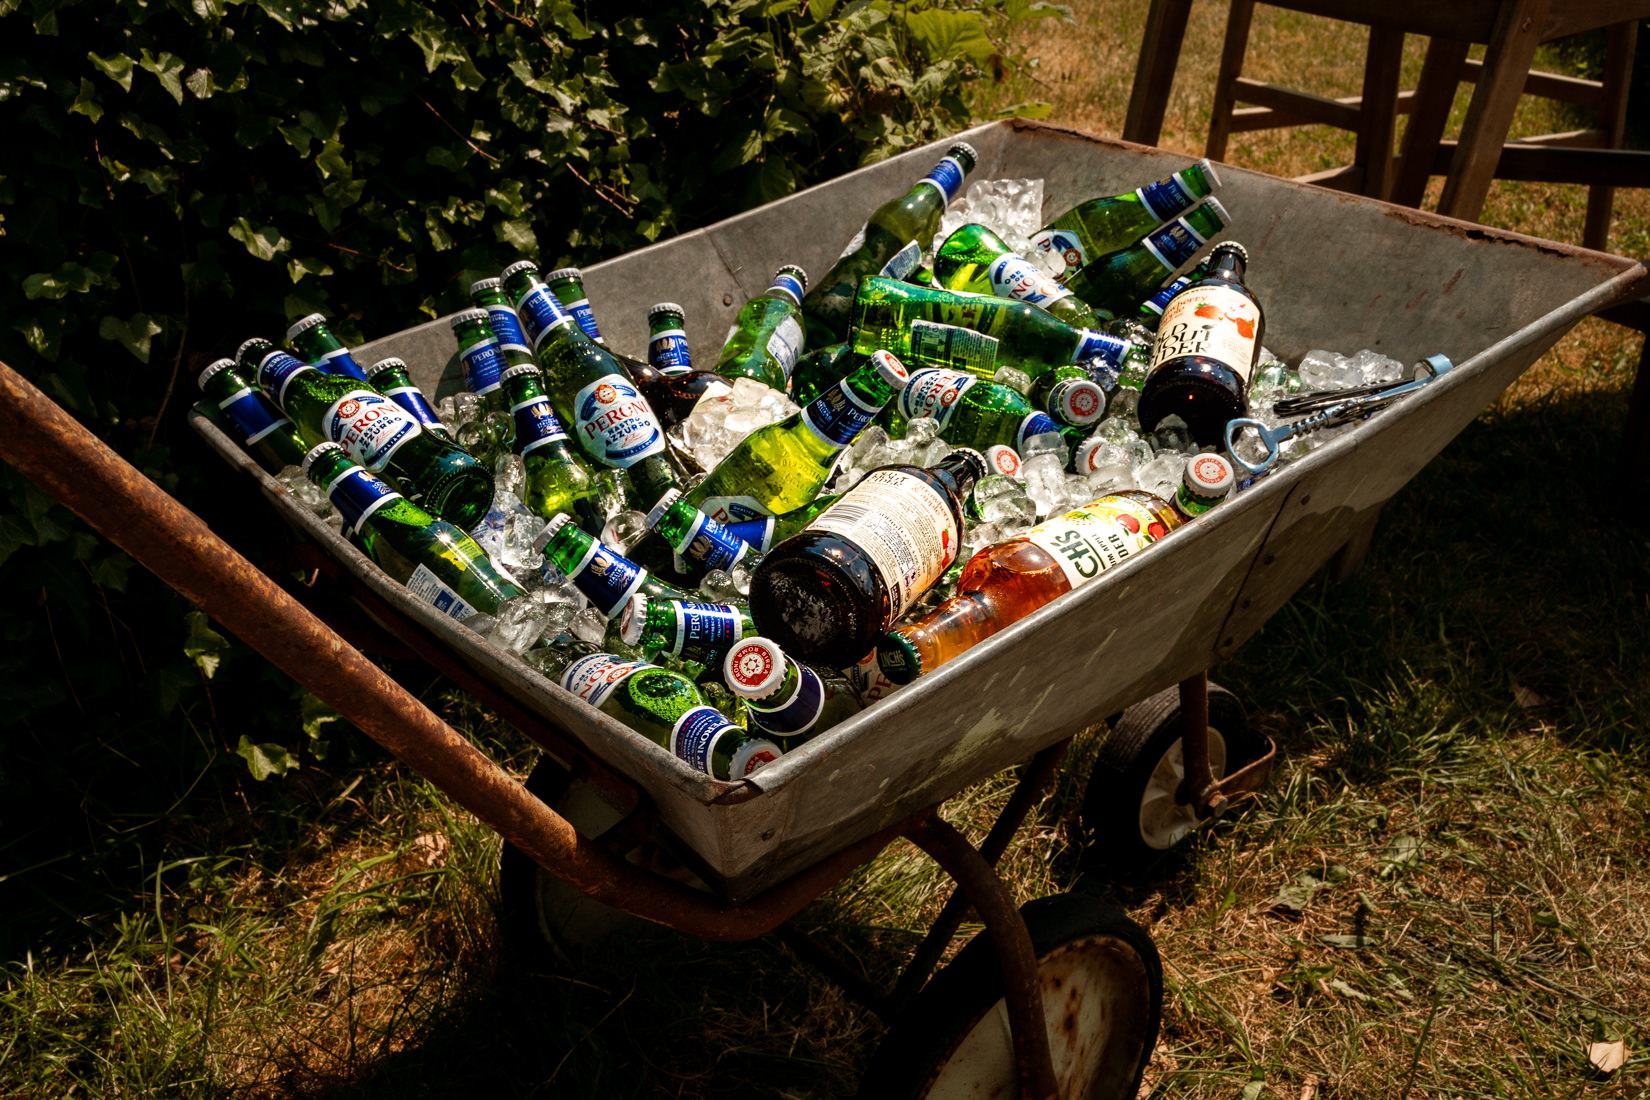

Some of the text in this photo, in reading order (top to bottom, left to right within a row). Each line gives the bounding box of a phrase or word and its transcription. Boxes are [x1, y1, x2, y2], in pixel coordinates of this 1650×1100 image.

[584, 400, 649, 440] PERONI
[607, 417, 640, 437] NASTRO
[1049, 530, 1100, 579] CH'S
[1108, 533, 1129, 558] DER
[737, 646, 760, 659] ROMA
[760, 651, 772, 675] BIRRA
[733, 660, 747, 683] PERONI
[697, 719, 729, 754] PERONI
